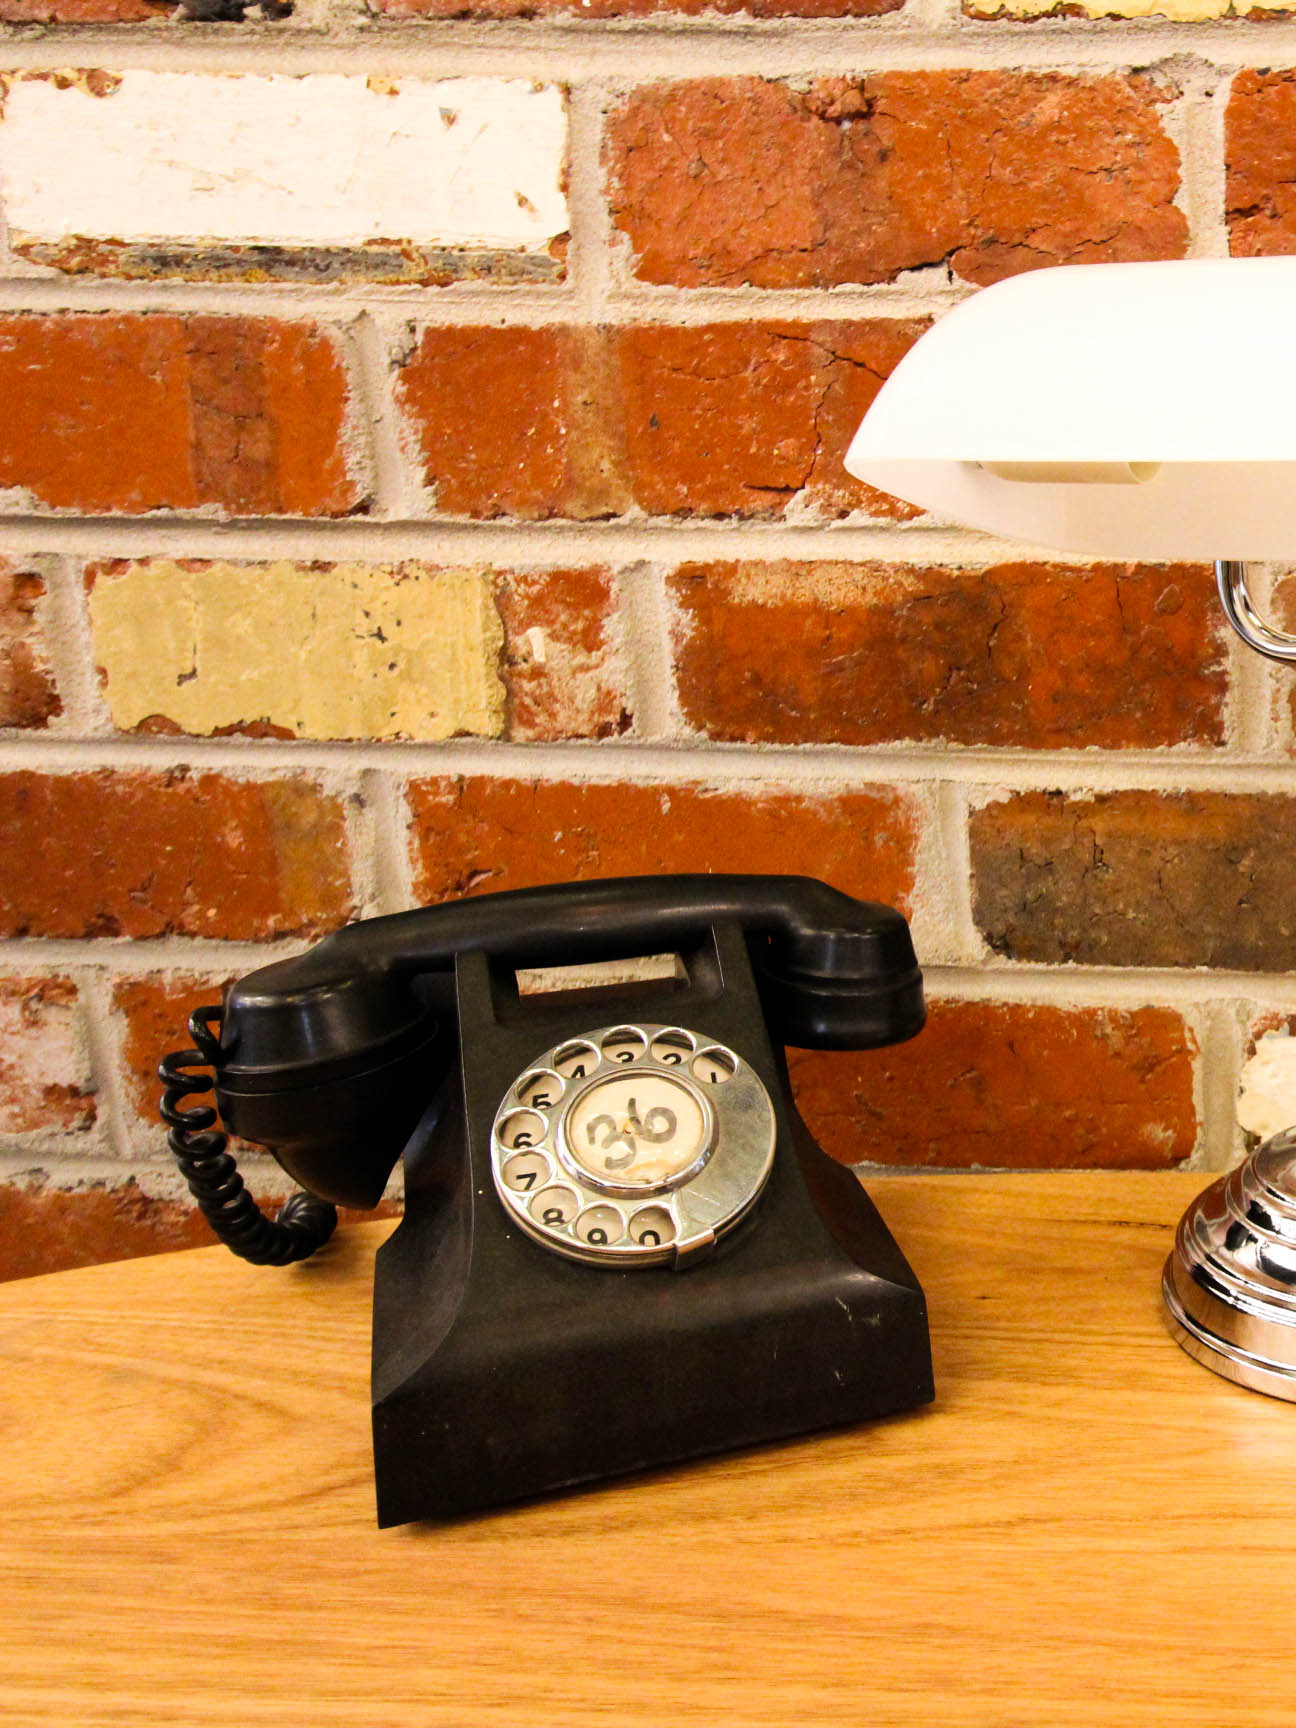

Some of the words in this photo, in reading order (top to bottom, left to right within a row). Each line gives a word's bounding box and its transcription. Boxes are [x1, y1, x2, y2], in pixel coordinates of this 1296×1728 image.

[532, 1093, 552, 1110] 5
[513, 1132, 533, 1149] 6
[516, 1172, 538, 1192] 7
[543, 1207, 566, 1227] 8
